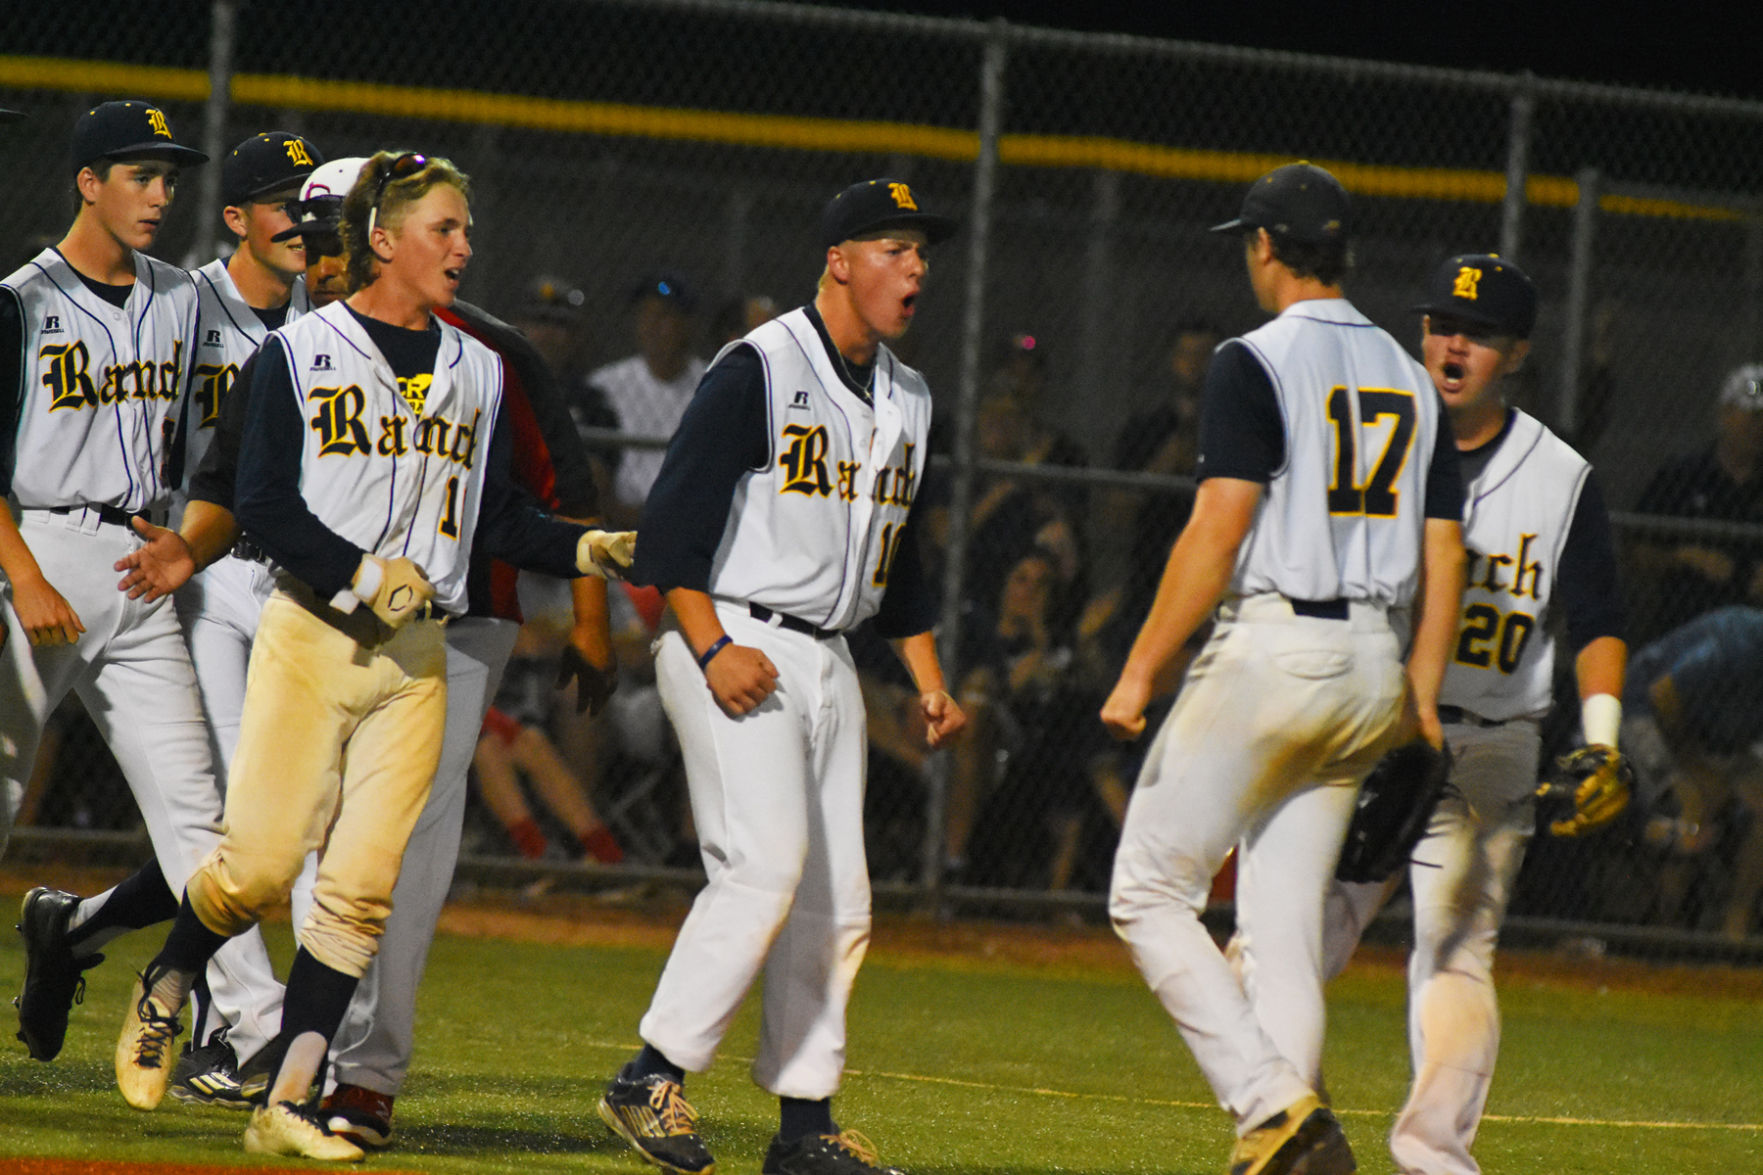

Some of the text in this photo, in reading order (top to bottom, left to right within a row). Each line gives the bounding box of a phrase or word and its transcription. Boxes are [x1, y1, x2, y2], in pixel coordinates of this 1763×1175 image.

[145, 109, 172, 139] R
[283, 139, 313, 167] R
[888, 182, 918, 211] R
[1453, 266, 1482, 300] R
[1325, 384, 1418, 519] 17
[1455, 602, 1535, 675] 20
